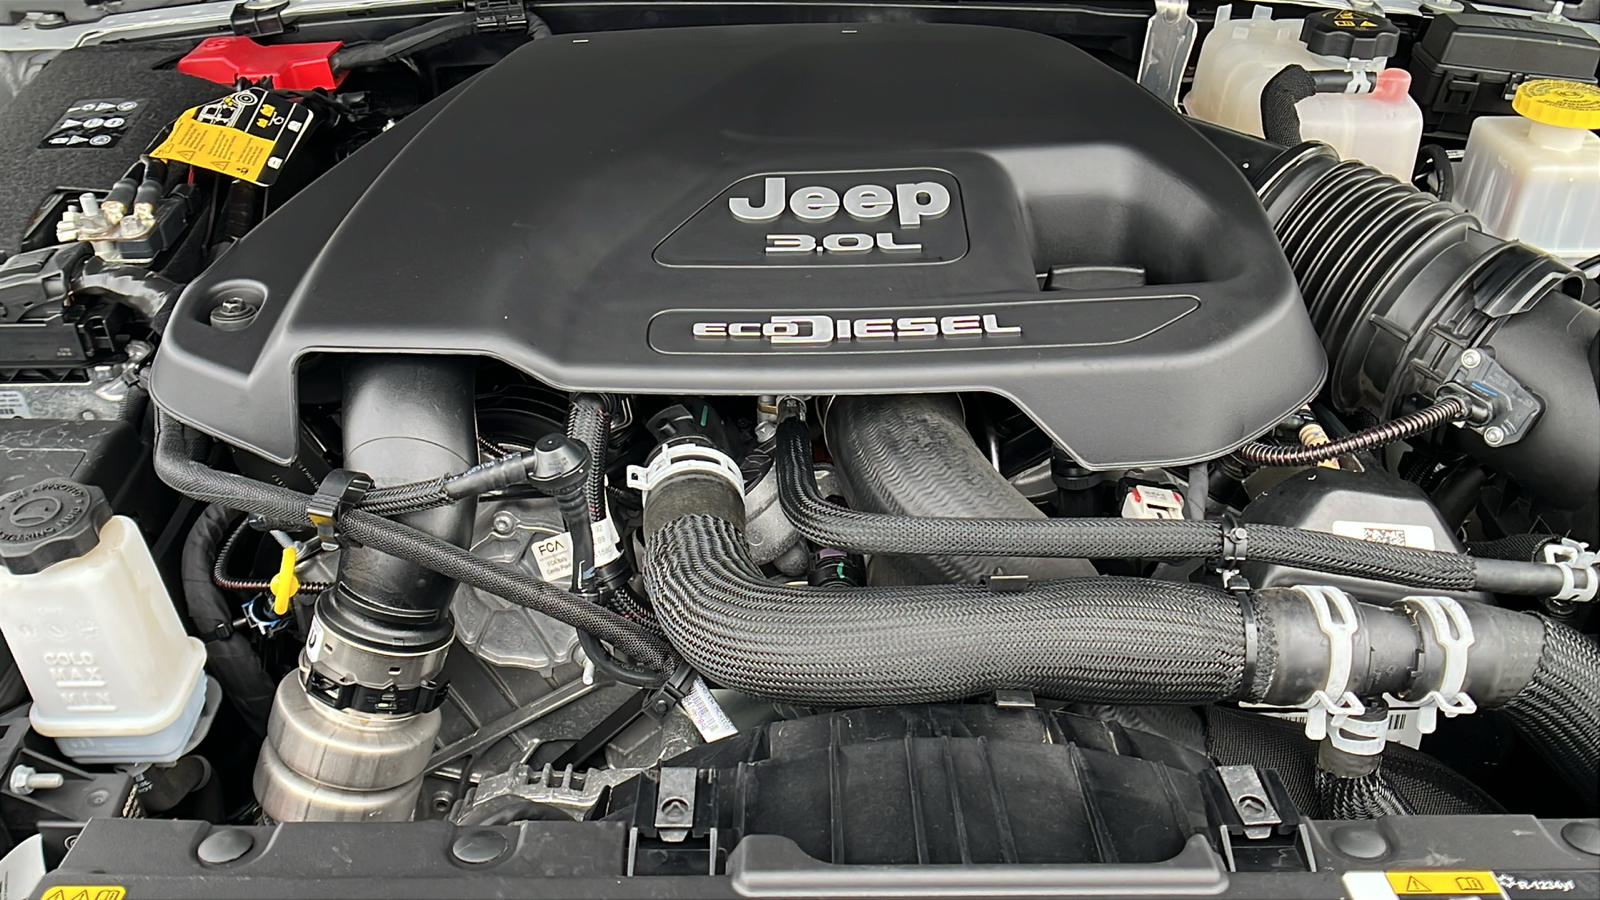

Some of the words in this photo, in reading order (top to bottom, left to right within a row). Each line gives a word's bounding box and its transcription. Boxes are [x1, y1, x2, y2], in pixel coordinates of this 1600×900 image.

[729, 178, 951, 226] Jeep
[765, 232, 923, 256] 3.0L
[538, 540, 564, 556] FCA
[43, 651, 96, 666] COLD
[49, 667, 103, 681] MAX
[60, 692, 111, 706] MIN
[1517, 879, 1576, 893] R-1234yf
